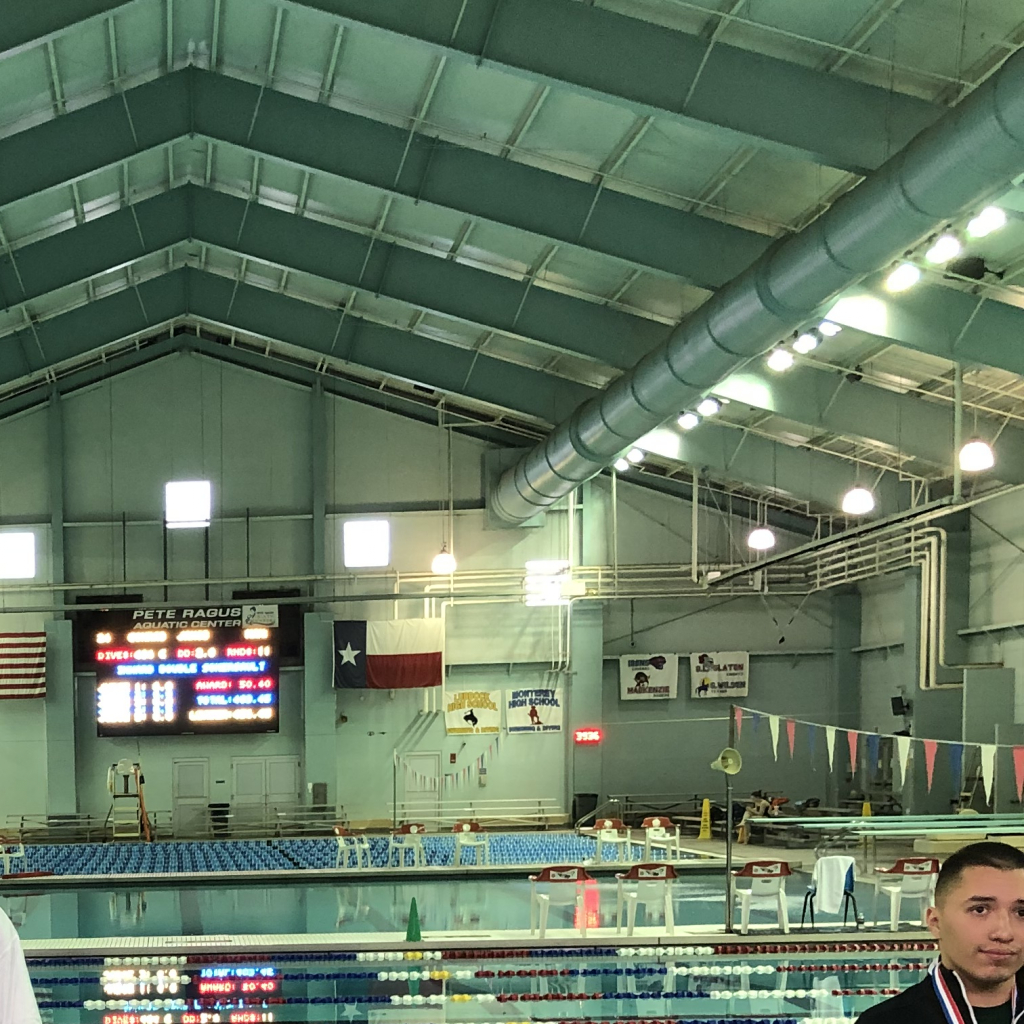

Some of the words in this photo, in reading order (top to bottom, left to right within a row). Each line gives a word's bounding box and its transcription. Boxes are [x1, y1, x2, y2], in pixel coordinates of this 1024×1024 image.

[132, 609, 176, 620] PETE
[182, 608, 241, 619] RAGUS
[133, 620, 188, 630] AQUATIC
[190, 619, 241, 629] CENTER
[238, 680, 272, 689] 50.40
[512, 689, 556, 699] MONTEREY
[508, 699, 527, 709] HIGH
[528, 698, 560, 707] SCHOOL
